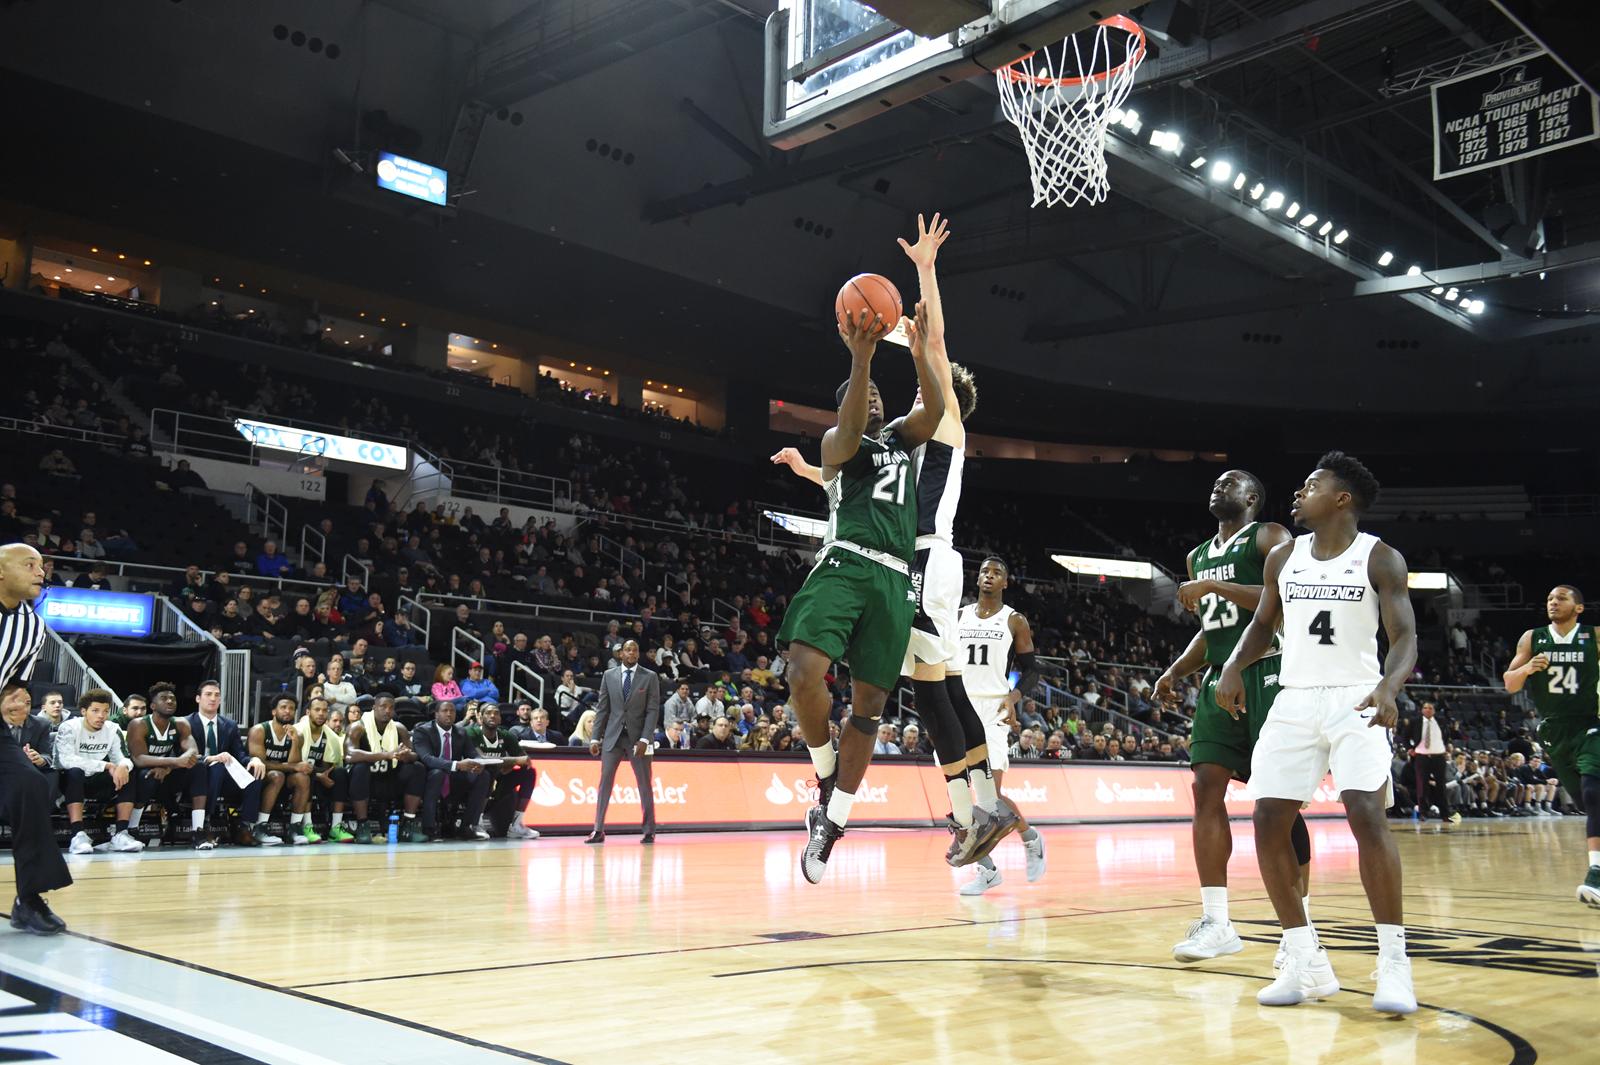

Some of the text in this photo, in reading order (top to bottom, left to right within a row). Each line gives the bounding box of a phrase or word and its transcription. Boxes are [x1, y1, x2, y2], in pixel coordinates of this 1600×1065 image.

[1445, 84, 1581, 133] NCAA TOURNAMENT
[1484, 80, 1539, 107] PROVIDENCE
[1458, 101, 1569, 143] 1964 1965 1966
[1459, 113, 1569, 154] 1972 1973 1974
[1459, 125, 1571, 165] 1977 1978 1987
[358, 443, 399, 465] COX
[300, 480, 321, 492] 122
[872, 463, 908, 506] 21
[1286, 582, 1365, 602] PROVIDENCE
[47, 601, 141, 623] BUD LIGHT
[1200, 592, 1239, 632] 23
[1308, 610, 1335, 646] 4
[966, 643, 989, 666] 11
[1548, 665, 1579, 694] 24
